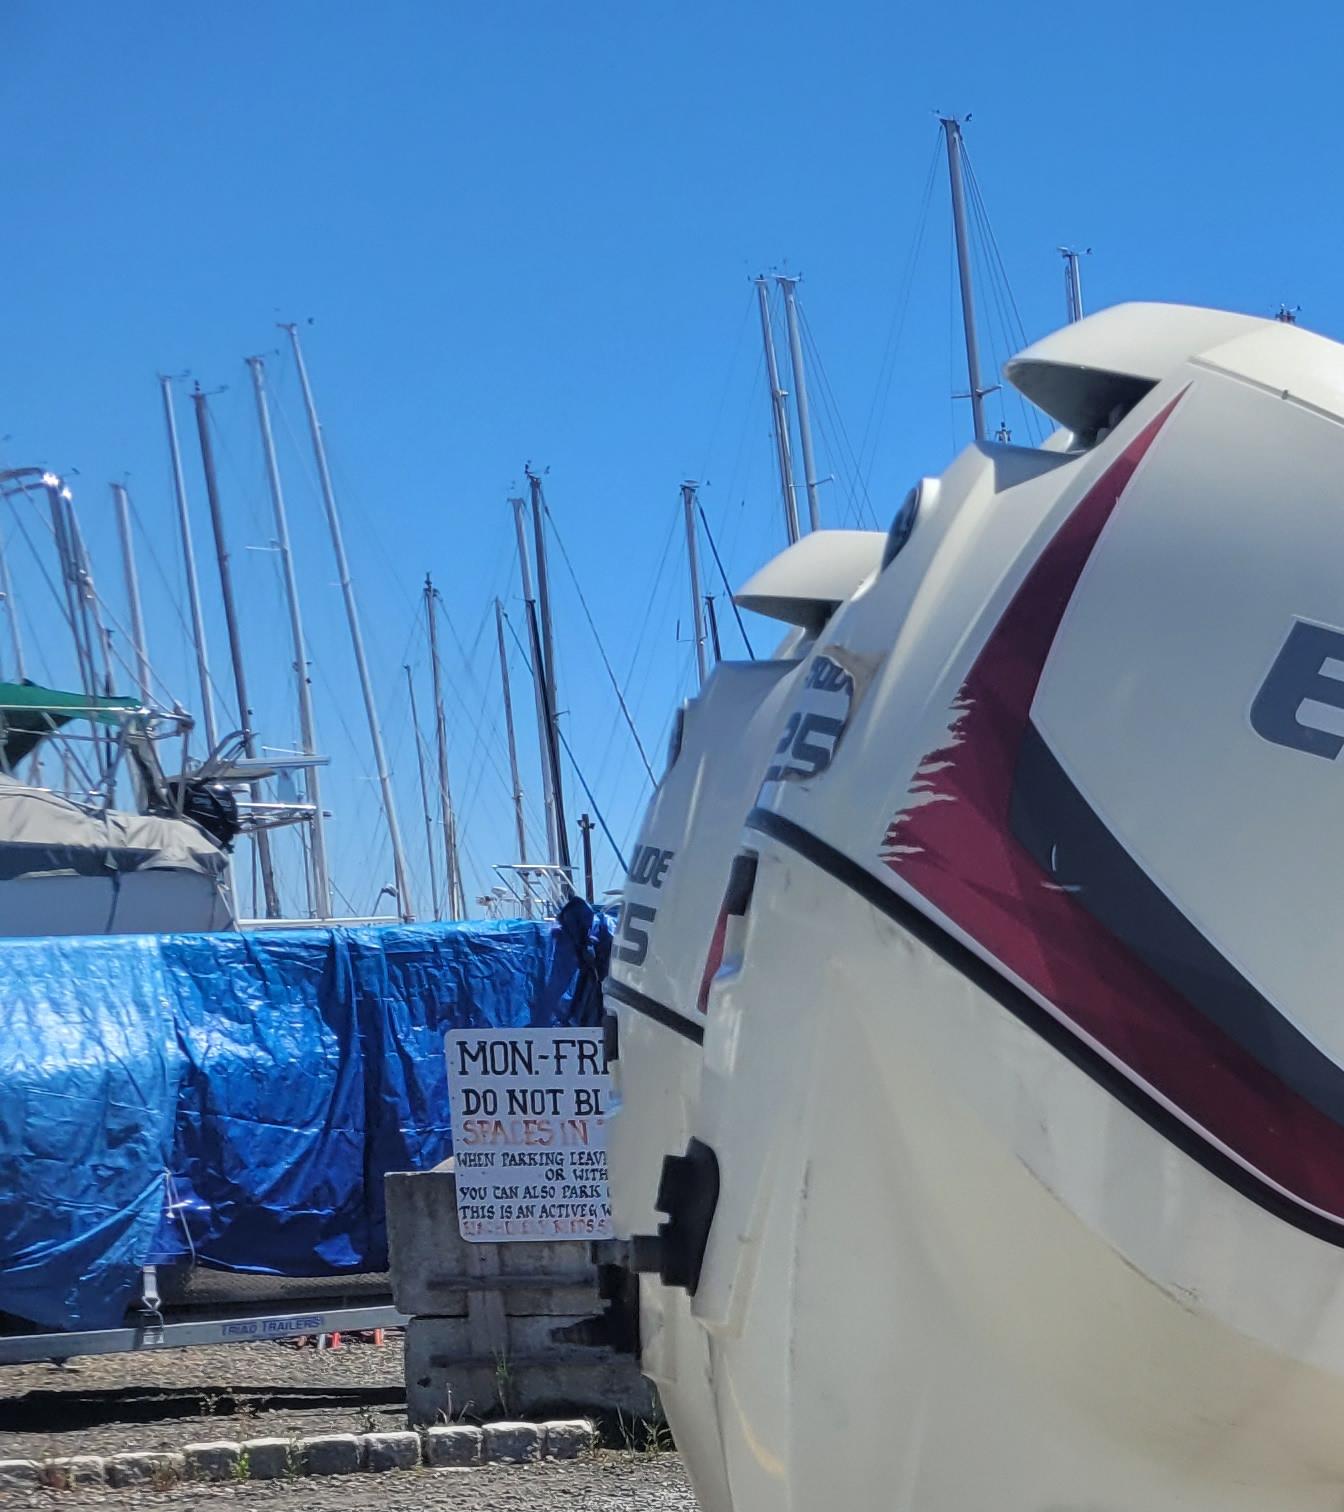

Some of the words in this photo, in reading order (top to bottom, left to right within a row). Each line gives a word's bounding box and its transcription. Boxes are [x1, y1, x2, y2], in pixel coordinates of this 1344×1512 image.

[612, 902, 657, 967] 5
[461, 1088, 498, 1115] DO
[506, 1088, 564, 1115] NOT
[456, 1151, 495, 1167] WHEN
[501, 1151, 565, 1167] PARKING
[569, 1150, 607, 1166] LEAV
[545, 1168, 566, 1182] OR
[459, 1186, 487, 1201] YOU
[493, 1185, 520, 1199] CAN
[523, 1185, 556, 1199] ALSO
[562, 1184, 601, 1199] PARK
[459, 1205, 495, 1220] THIS
[500, 1205, 514, 1219] IS
[516, 1204, 536, 1219] AN
